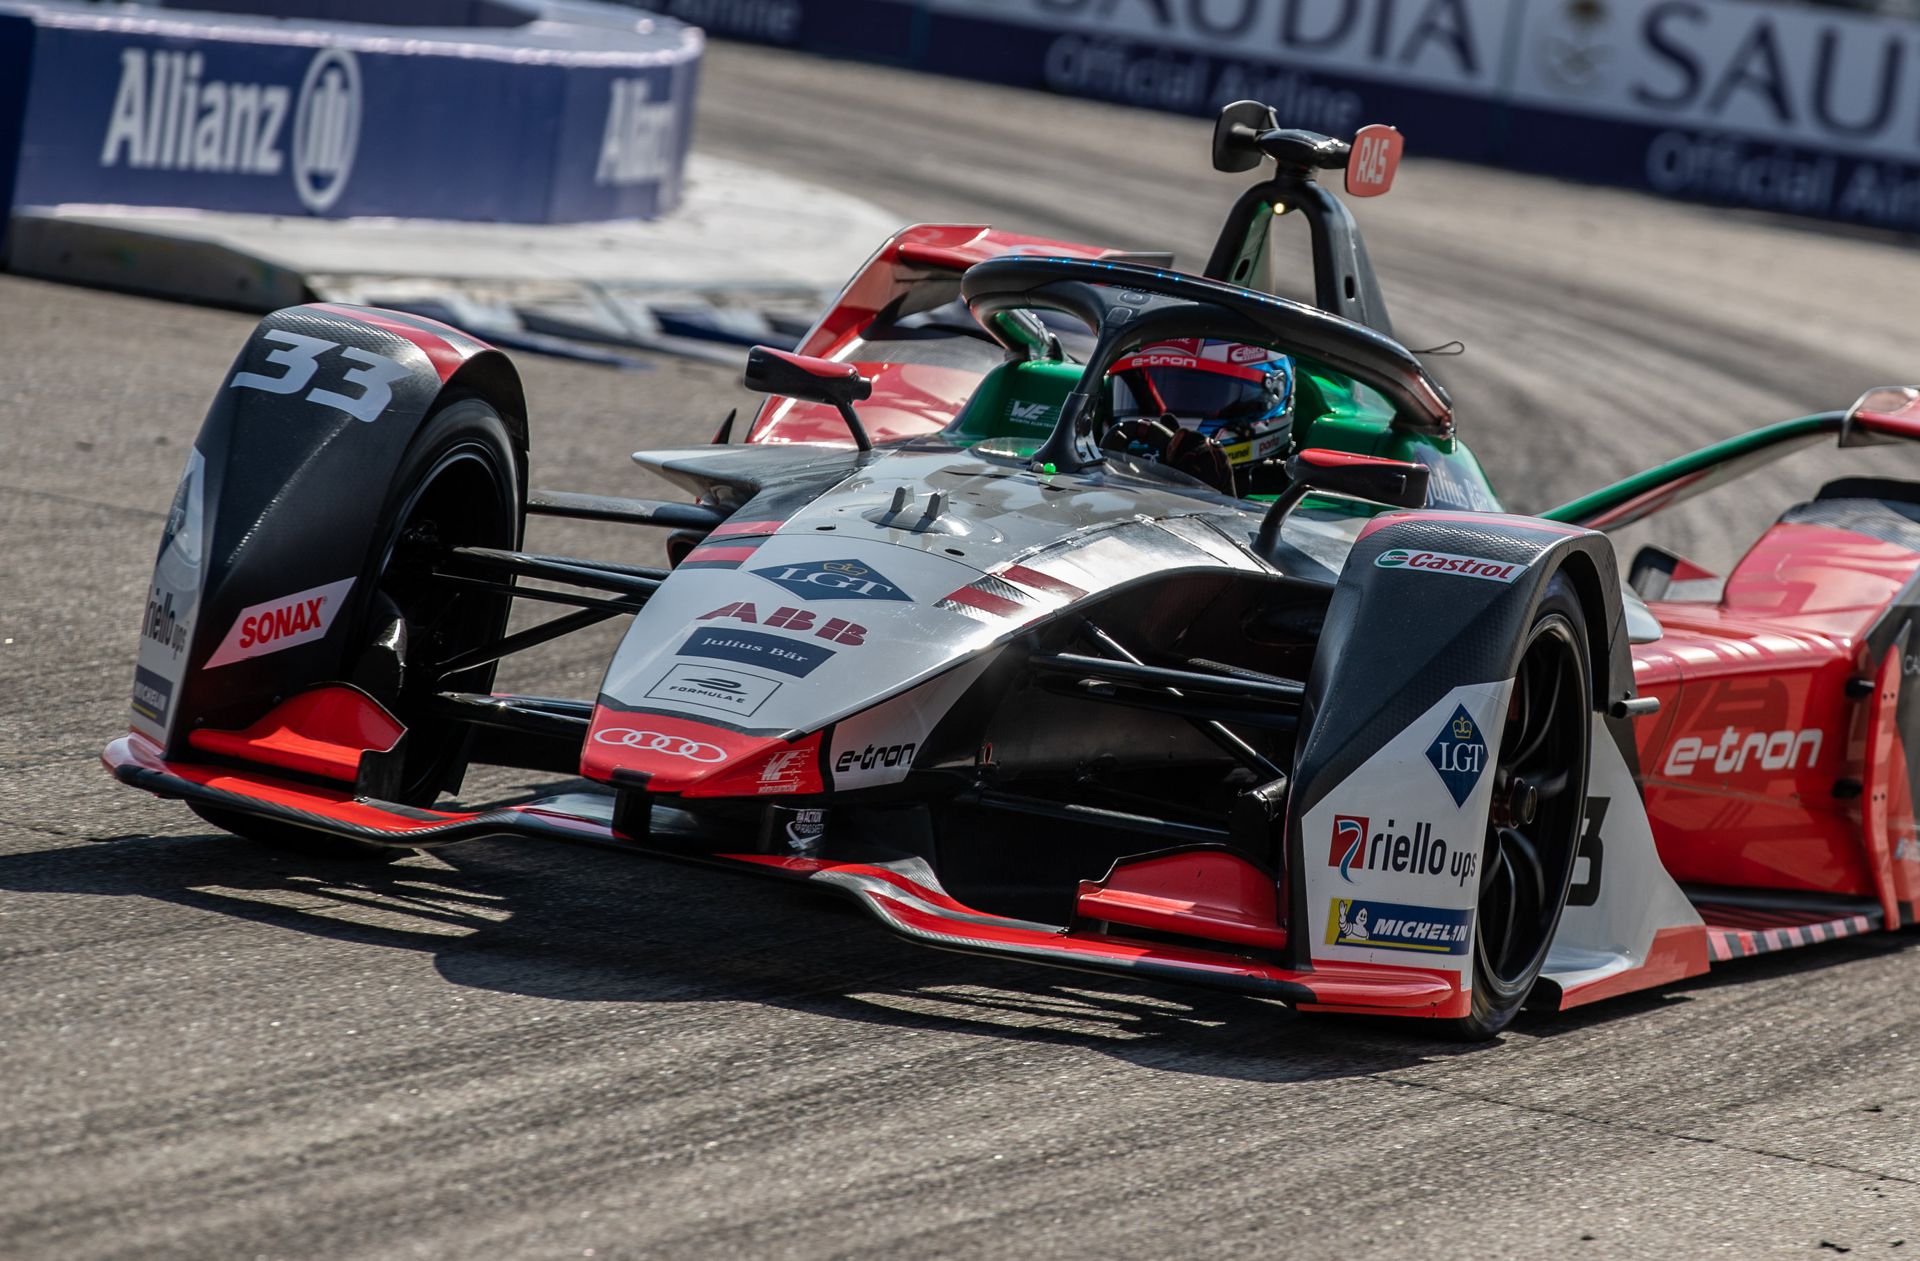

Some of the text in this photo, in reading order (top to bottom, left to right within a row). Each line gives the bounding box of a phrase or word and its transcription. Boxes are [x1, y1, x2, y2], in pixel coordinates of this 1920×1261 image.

[1628, 0, 1920, 150] SAU
[101, 48, 292, 176] Allianz
[1355, 136, 1390, 184] RAS
[230, 329, 415, 423] 33
[1131, 355, 1197, 368] e-tron
[771, 566, 894, 597] LGT
[1409, 552, 1516, 580] Castrol
[239, 596, 324, 649] SONAX
[695, 601, 869, 647] ABB
[701, 637, 809, 662] Julius Bär
[668, 685, 734, 702] FORMULA
[835, 742, 916, 774] e-tron
[1439, 742, 1484, 773] LGT
[1663, 726, 1824, 777] e-tron
[1367, 819, 1478, 887] riello ups
[1373, 918, 1468, 942] MICHELIN
